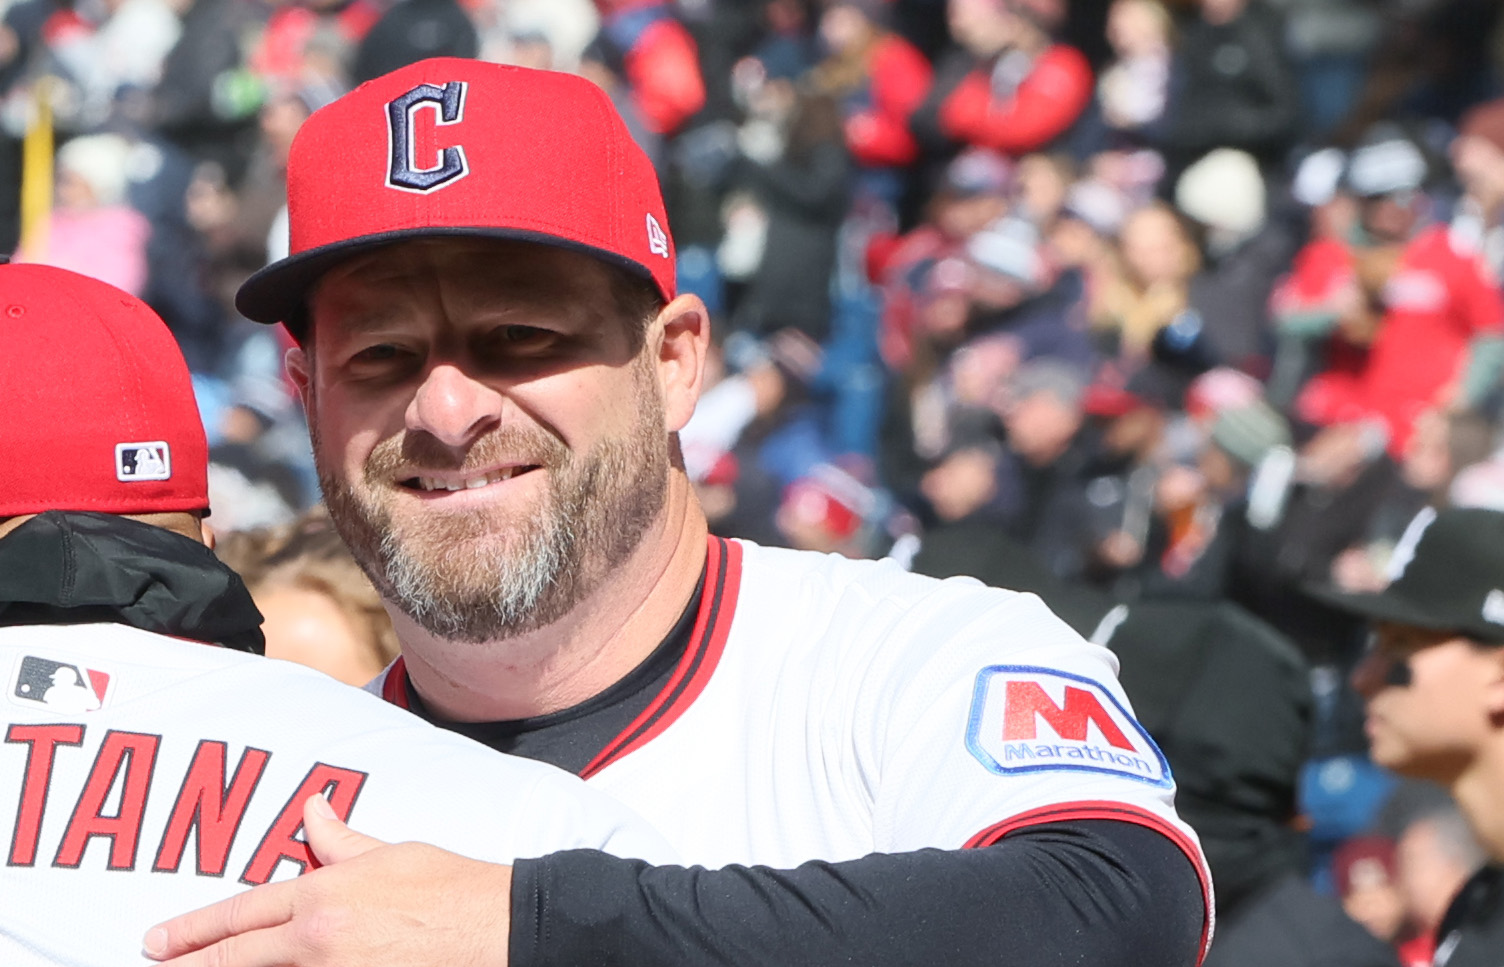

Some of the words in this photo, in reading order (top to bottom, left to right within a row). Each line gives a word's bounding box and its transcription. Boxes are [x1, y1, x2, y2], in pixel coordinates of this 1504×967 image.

[384, 81, 470, 195] C
[1002, 681, 1139, 753] M
[1004, 744, 1153, 774] Marathon
